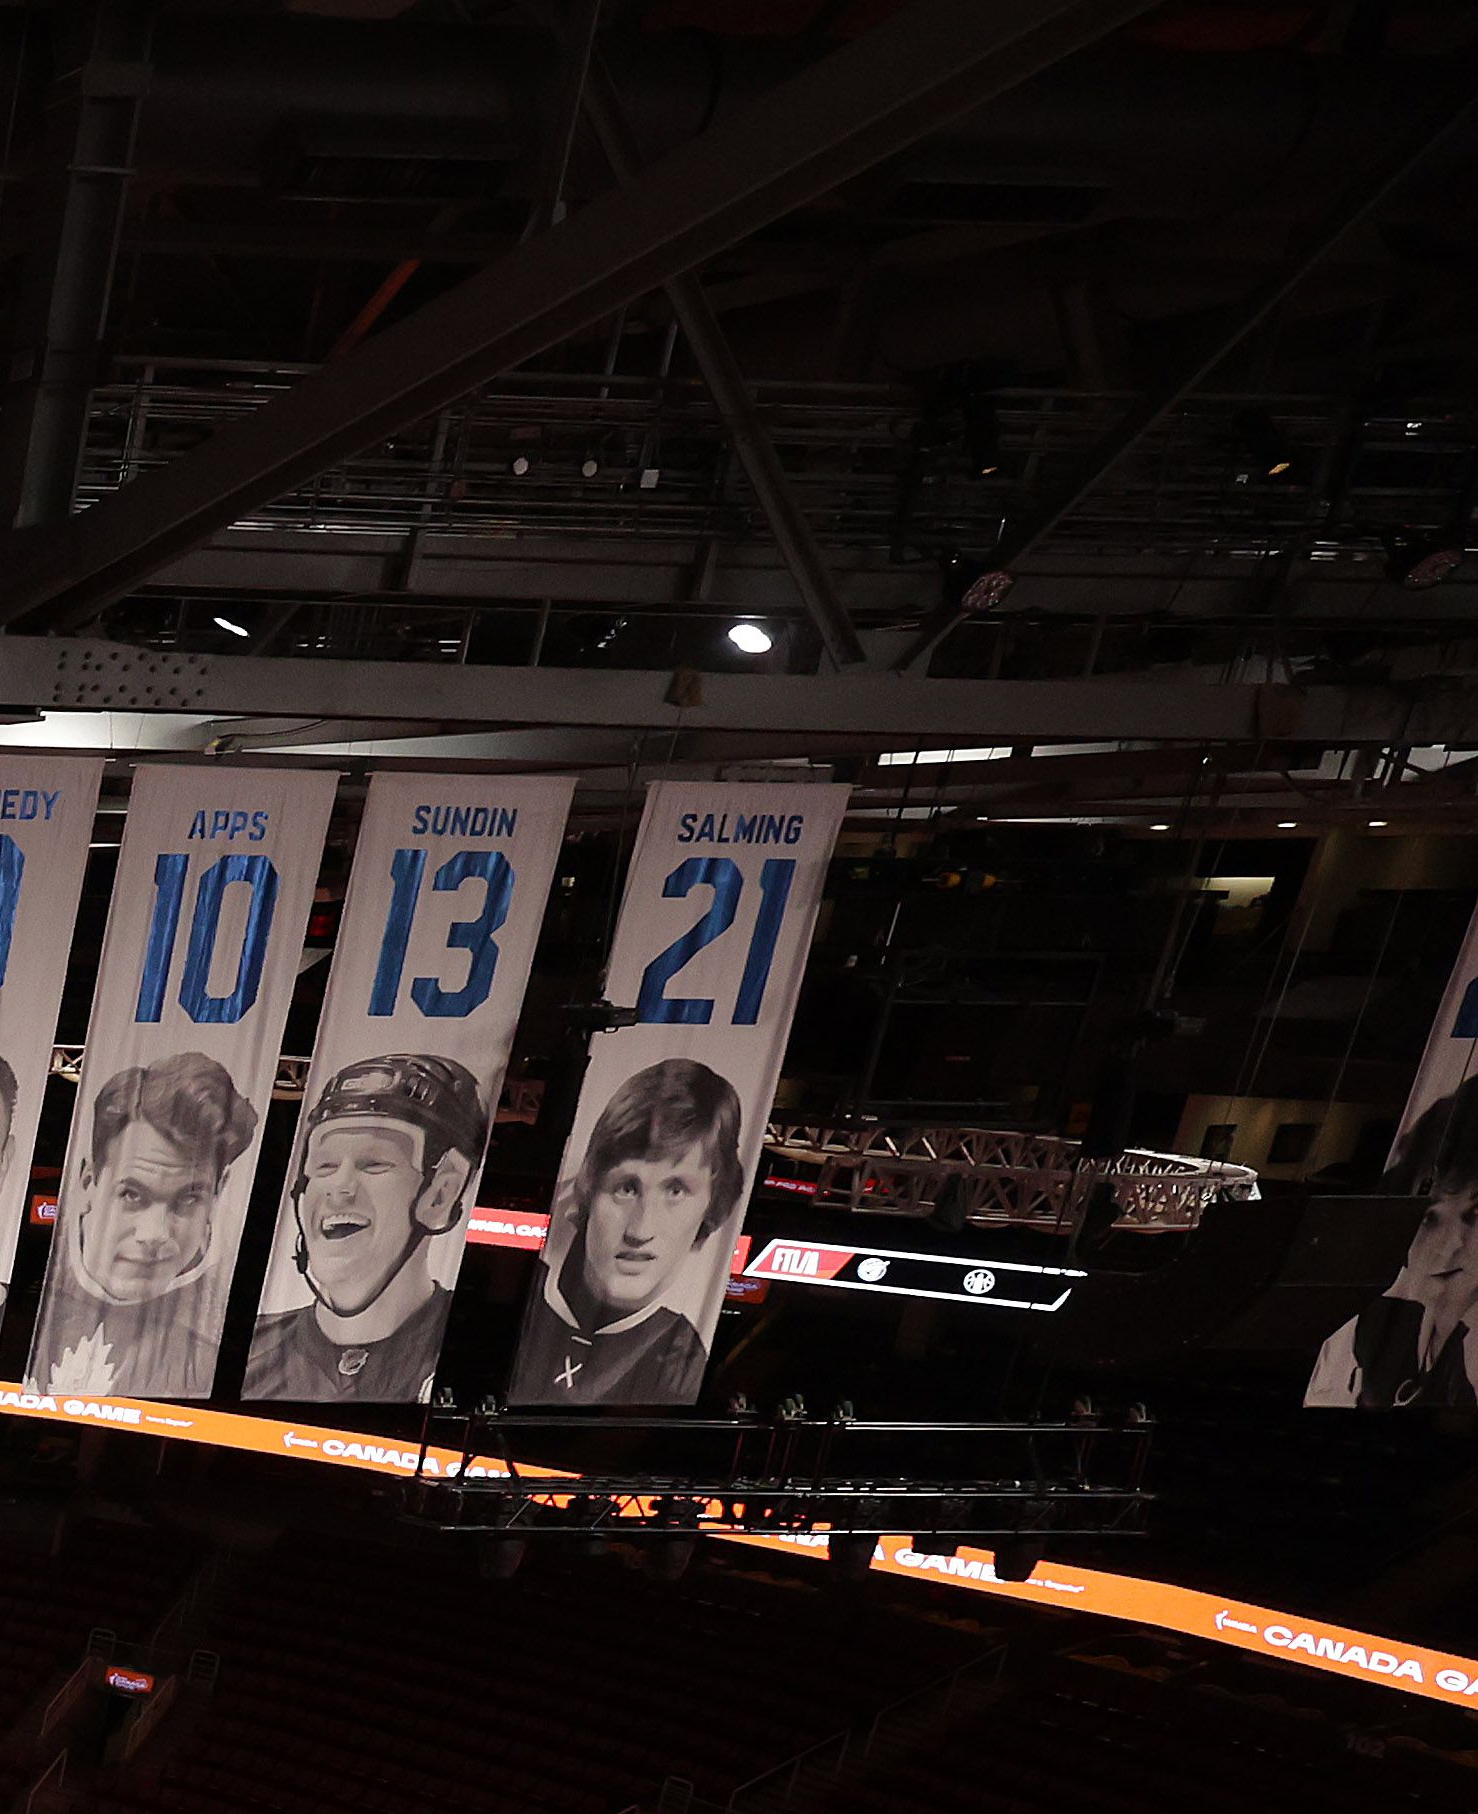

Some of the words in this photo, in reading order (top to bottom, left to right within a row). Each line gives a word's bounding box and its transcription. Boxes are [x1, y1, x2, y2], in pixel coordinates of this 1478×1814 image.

[187, 809, 269, 842] APPS
[411, 805, 518, 838] SUNDIN
[676, 813, 804, 844] SALMING
[134, 853, 279, 1024] 10
[367, 848, 515, 1018] 13
[636, 857, 796, 1025] 21
[63, 1400, 141, 1424] GAME
[322, 1438, 441, 1476] CANADA
[1264, 1625, 1423, 1684] CANADA
[1435, 1670, 1478, 1695] GA
